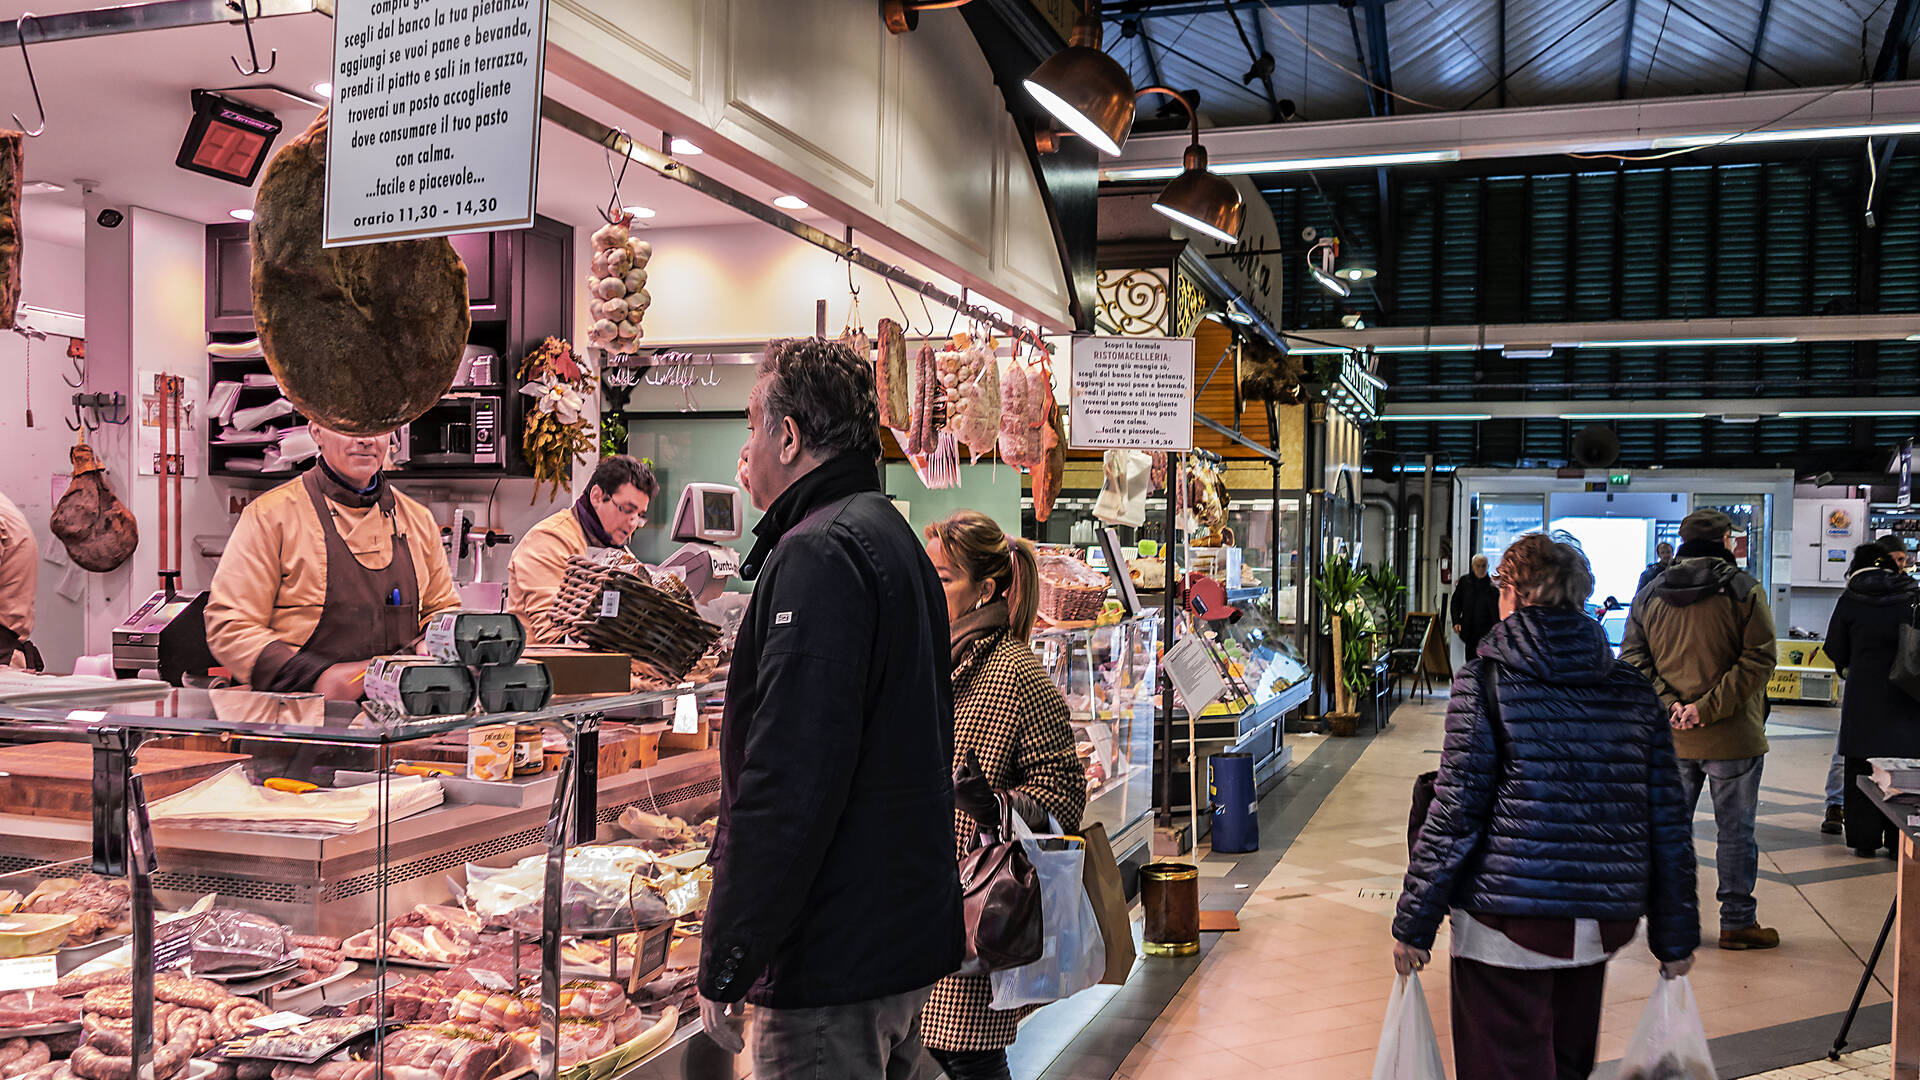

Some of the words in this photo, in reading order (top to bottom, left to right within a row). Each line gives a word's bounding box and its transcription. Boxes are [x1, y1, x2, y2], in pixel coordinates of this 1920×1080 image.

[344, 25, 374, 48] scegli
[378, 19, 394, 40] dal
[398, 16, 430, 35] banco
[435, 8, 445, 27] la
[450, 8, 468, 23] tua
[472, 0, 529, 22] pietanza,
[340, 55, 386, 77] aggiungi
[389, 50, 401, 63] se
[405, 40, 428, 60] vuoi
[432, 35, 460, 58] pane
[464, 34, 471, 47] e
[475, 17, 532, 45] bevanda,
[341, 79, 374, 103] prendi
[377, 73, 384, 92] il
[388, 67, 420, 93] piatto
[424, 68, 431, 82] e
[434, 61, 455, 80] sali
[459, 57, 470, 75] in
[475, 50, 528, 72] terrazza,
[348, 103, 389, 124] troverai
[393, 101, 405, 115] un
[409, 93, 440, 117] posto
[443, 80, 511, 107] accogliente
[351, 129, 376, 148] dove
[379, 123, 437, 144] consumare
[441, 114, 448, 134] il
[452, 116, 471, 132] tuo
[475, 109, 509, 131] pasto
[396, 152, 414, 168] con
[417, 144, 455, 164] calma.
[366, 177, 406, 198] ...facile
[409, 179, 416, 192] e
[419, 167, 485, 195] piacevole...
[354, 212, 394, 227] orario
[399, 205, 437, 223] 11,30
[456, 198, 498, 217] 14,30
[1104, 341, 1124, 350] Scopri
[1135, 342, 1160, 350] formula
[1121, 361, 1131, 370] giù
[1134, 363, 1158, 371] mangia
[1134, 371, 1140, 379] la
[1108, 390, 1127, 398] piatto
[1157, 382, 1187, 390] bevanda,
[1141, 400, 1178, 408] accogliente
